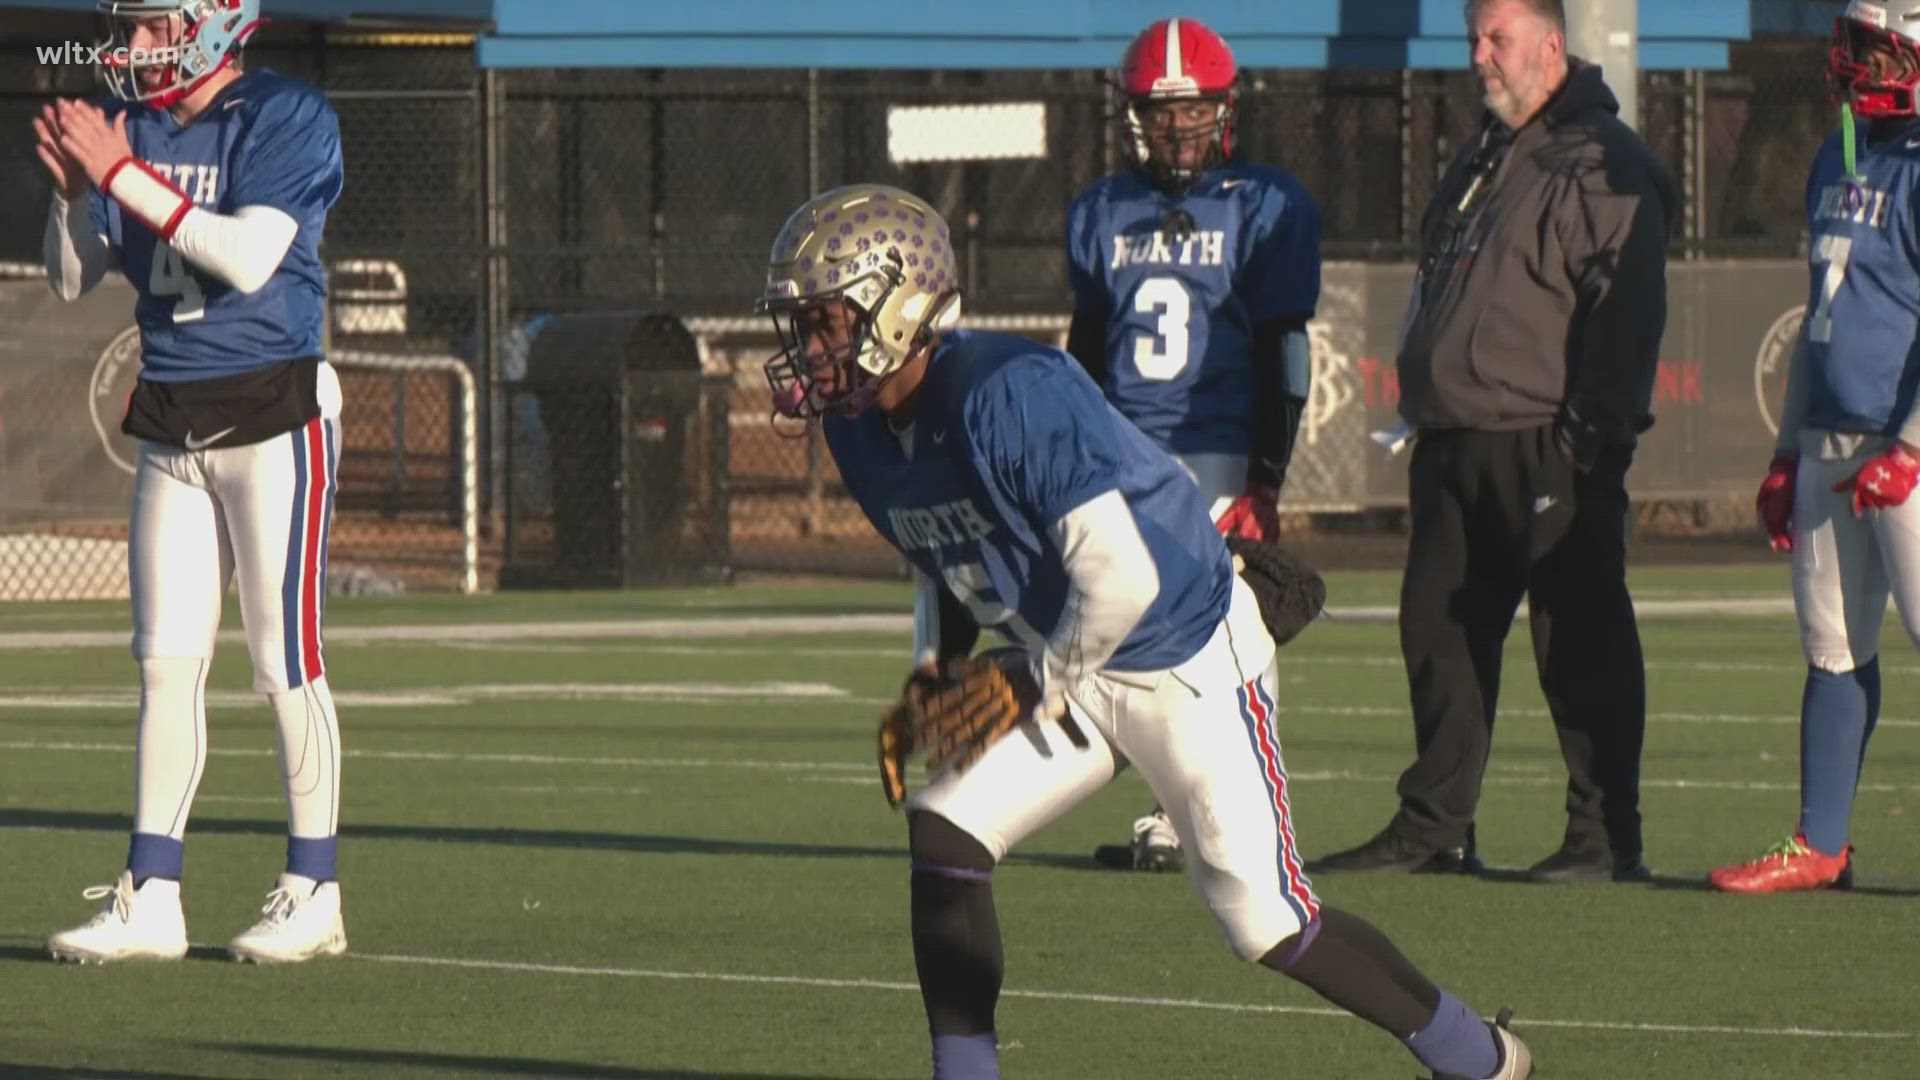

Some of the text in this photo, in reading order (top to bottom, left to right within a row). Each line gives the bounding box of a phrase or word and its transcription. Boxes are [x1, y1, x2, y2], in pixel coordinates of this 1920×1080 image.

[150, 237, 206, 323] 4
[1111, 230, 1224, 270] NORTH
[1809, 234, 1852, 343] 7
[1134, 278, 1190, 381] 3
[887, 498, 995, 549] NORTH
